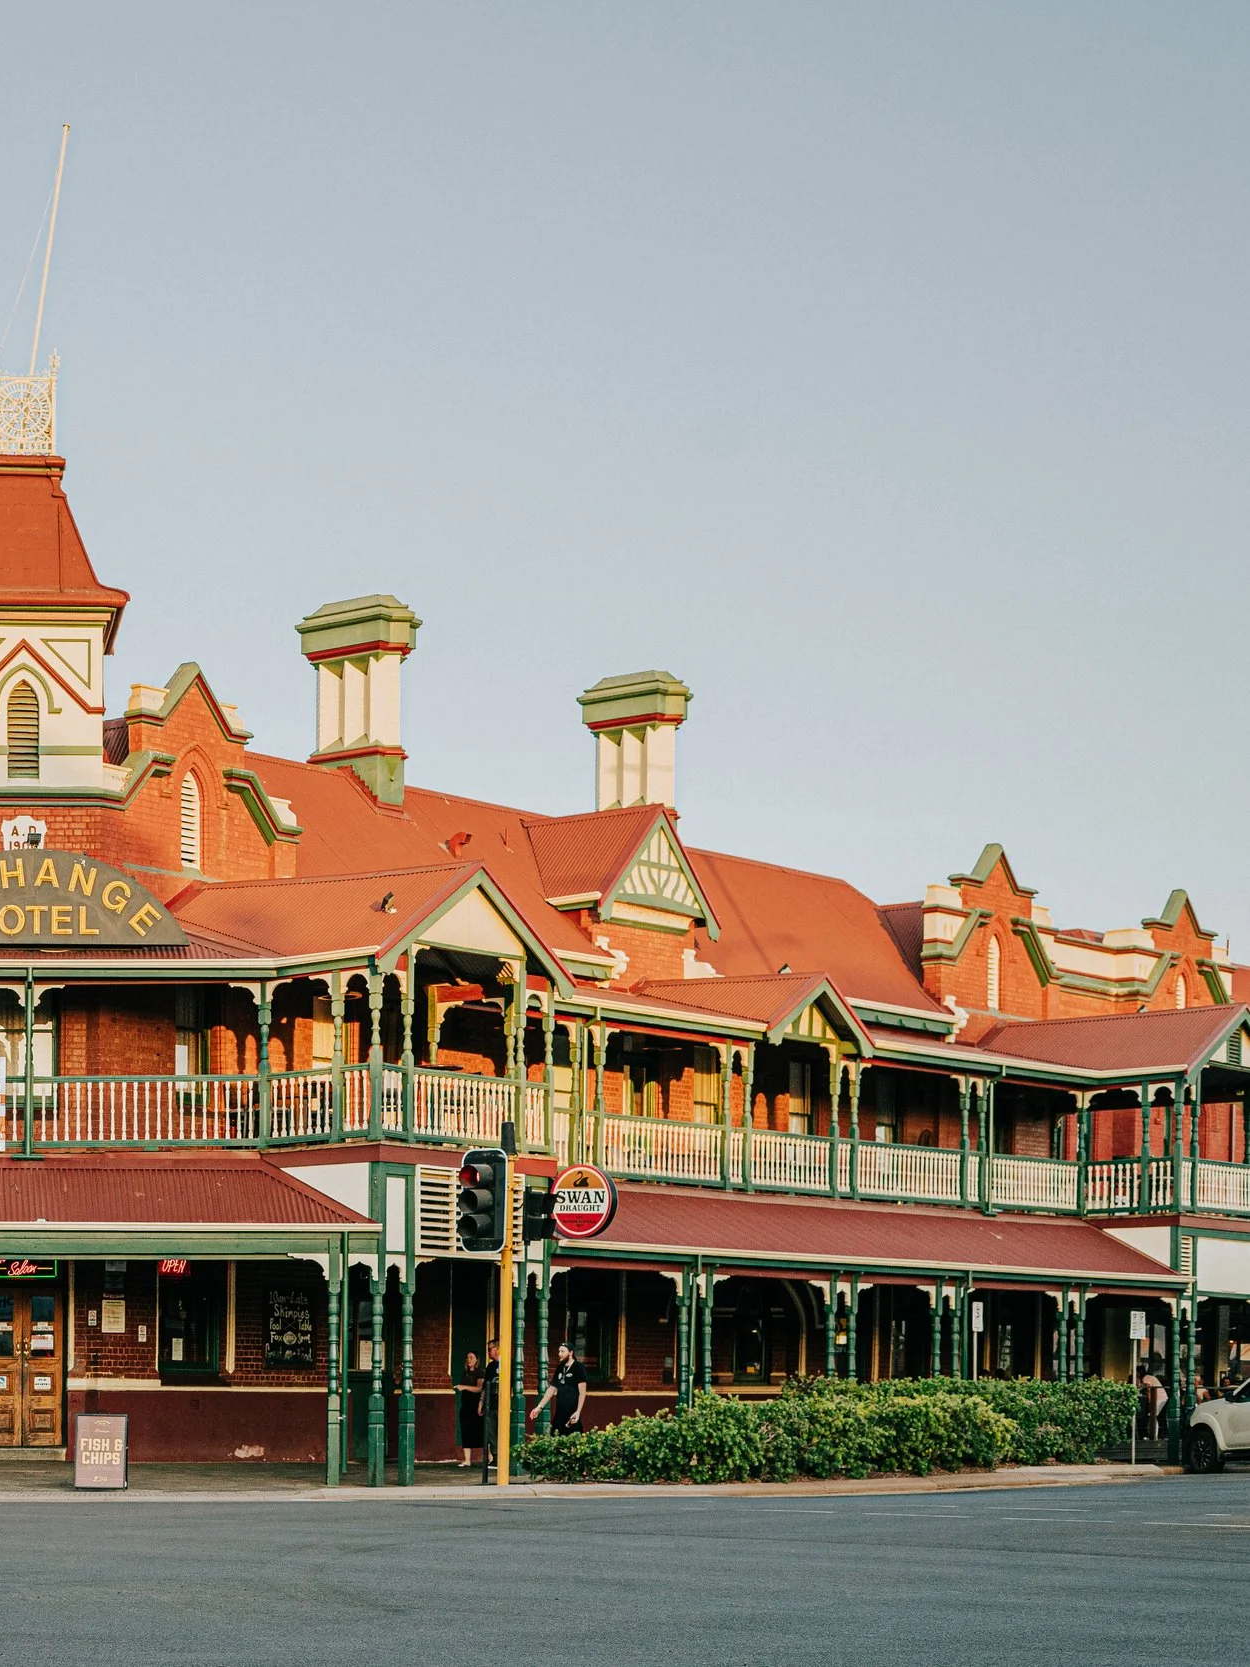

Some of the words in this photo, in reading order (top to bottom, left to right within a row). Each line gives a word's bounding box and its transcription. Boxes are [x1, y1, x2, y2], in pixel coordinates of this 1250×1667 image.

[555, 1190, 606, 1204] SWAN
[7, 1259, 38, 1276] Saloon
[161, 1259, 187, 1273] OPEN
[273, 1303, 310, 1321] Skimpies
[269, 1317, 282, 1330] Pool
[80, 1438, 110, 1451] FISH
[114, 1438, 124, 1452] &
[81, 1451, 121, 1465] CHIPS
